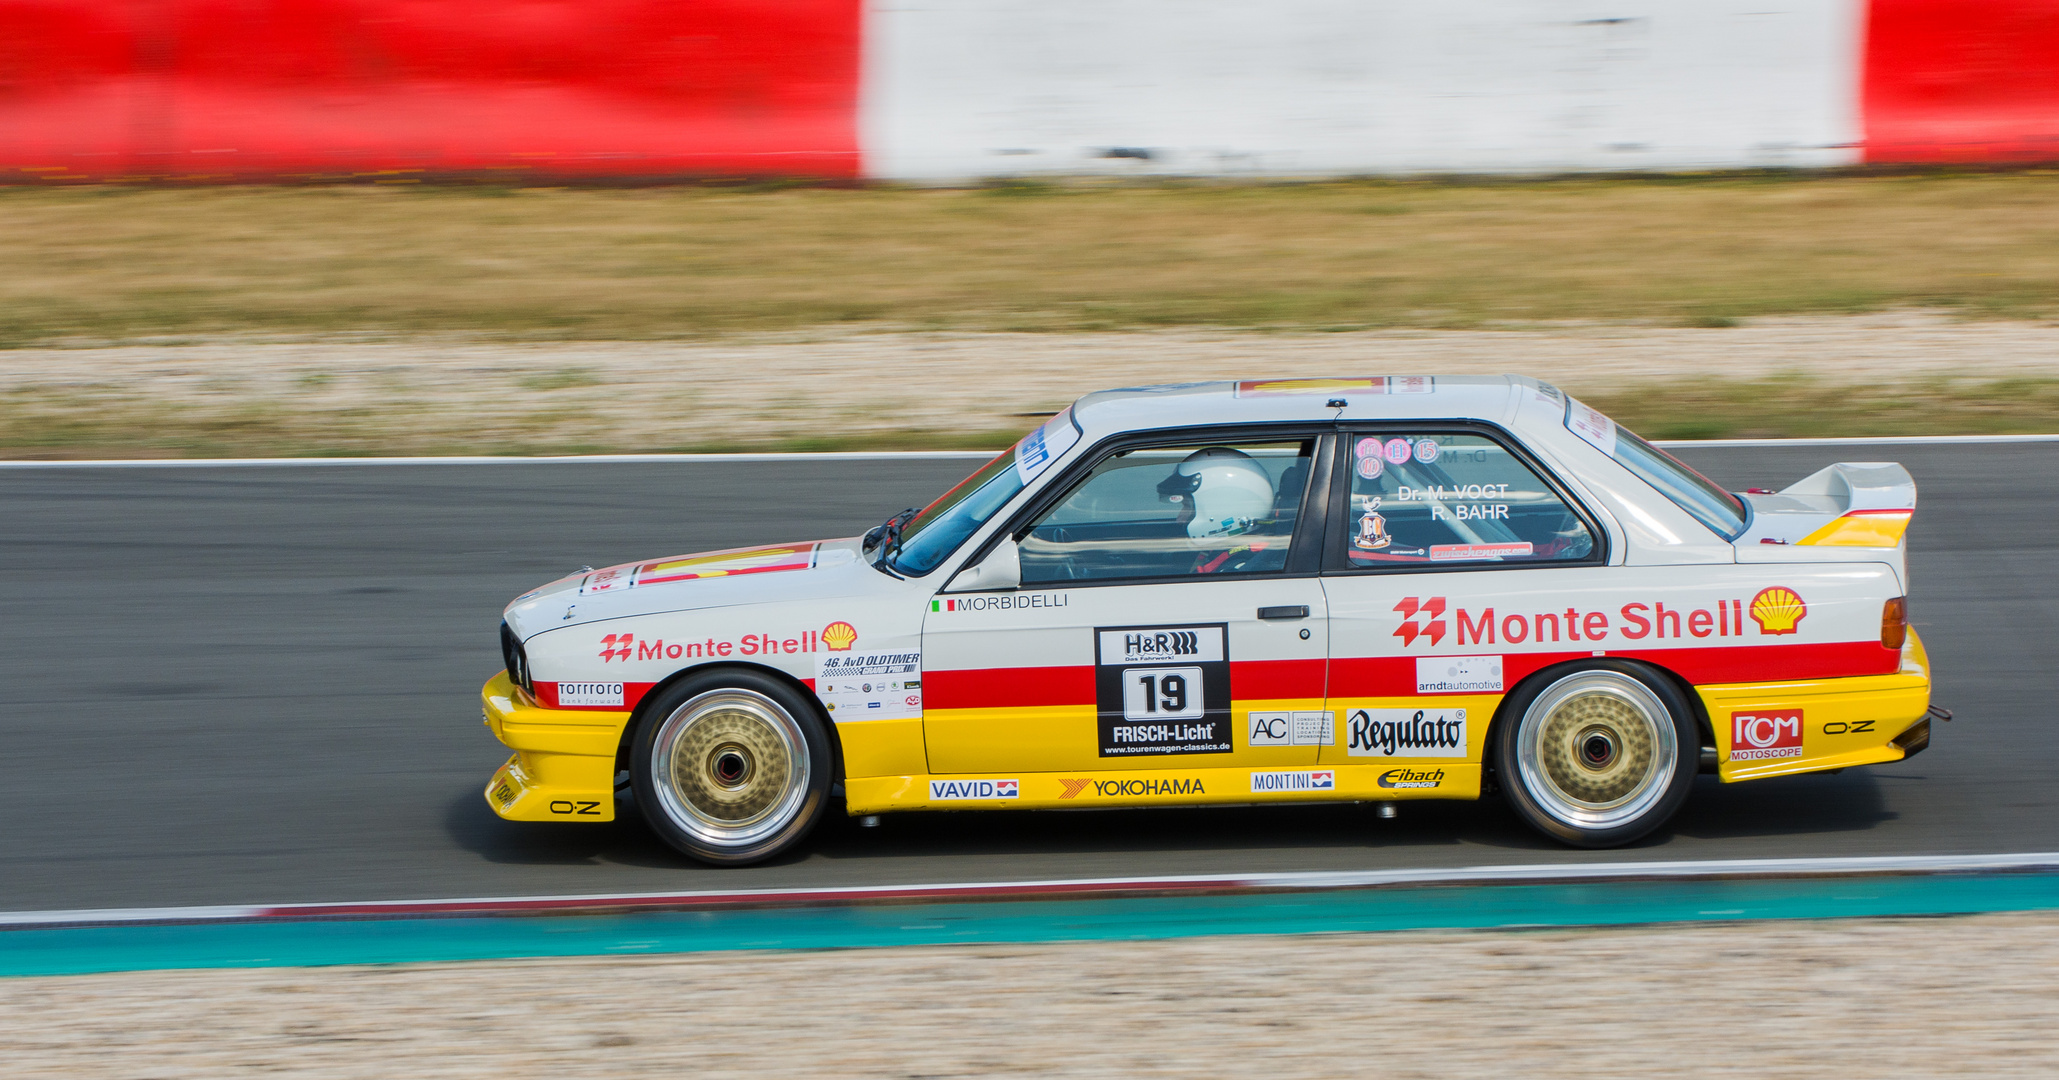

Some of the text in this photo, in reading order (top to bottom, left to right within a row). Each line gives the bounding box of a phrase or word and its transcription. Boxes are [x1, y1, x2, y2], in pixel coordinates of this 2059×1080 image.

[1419, 443, 1435, 458] 15
[1398, 484, 1509, 501] Dr. M. VOGT
[1432, 504, 1510, 521] R. BAHR
[1433, 547, 1530, 559] zwischengas.com
[958, 594, 1068, 611] MORBIDELLI
[1456, 599, 1743, 646] Monte Shell
[638, 630, 817, 661] Monte Shell
[1124, 632, 1172, 656] H&R
[824, 653, 920, 668] 46. AvD OLDTIMER
[1138, 673, 1189, 714] 19
[1418, 681, 1502, 691] arndtautomotive
[1252, 718, 1287, 739] AC
[1105, 743, 1231, 754] www.tourenwagen-classics.de
[1731, 748, 1802, 761] MOTOSCOPE
[1254, 773, 1310, 790] MONTINI
[1377, 768, 1445, 788] Eibach
[931, 782, 993, 798] VAVID
[1093, 778, 1206, 797] YOKOHAMA
